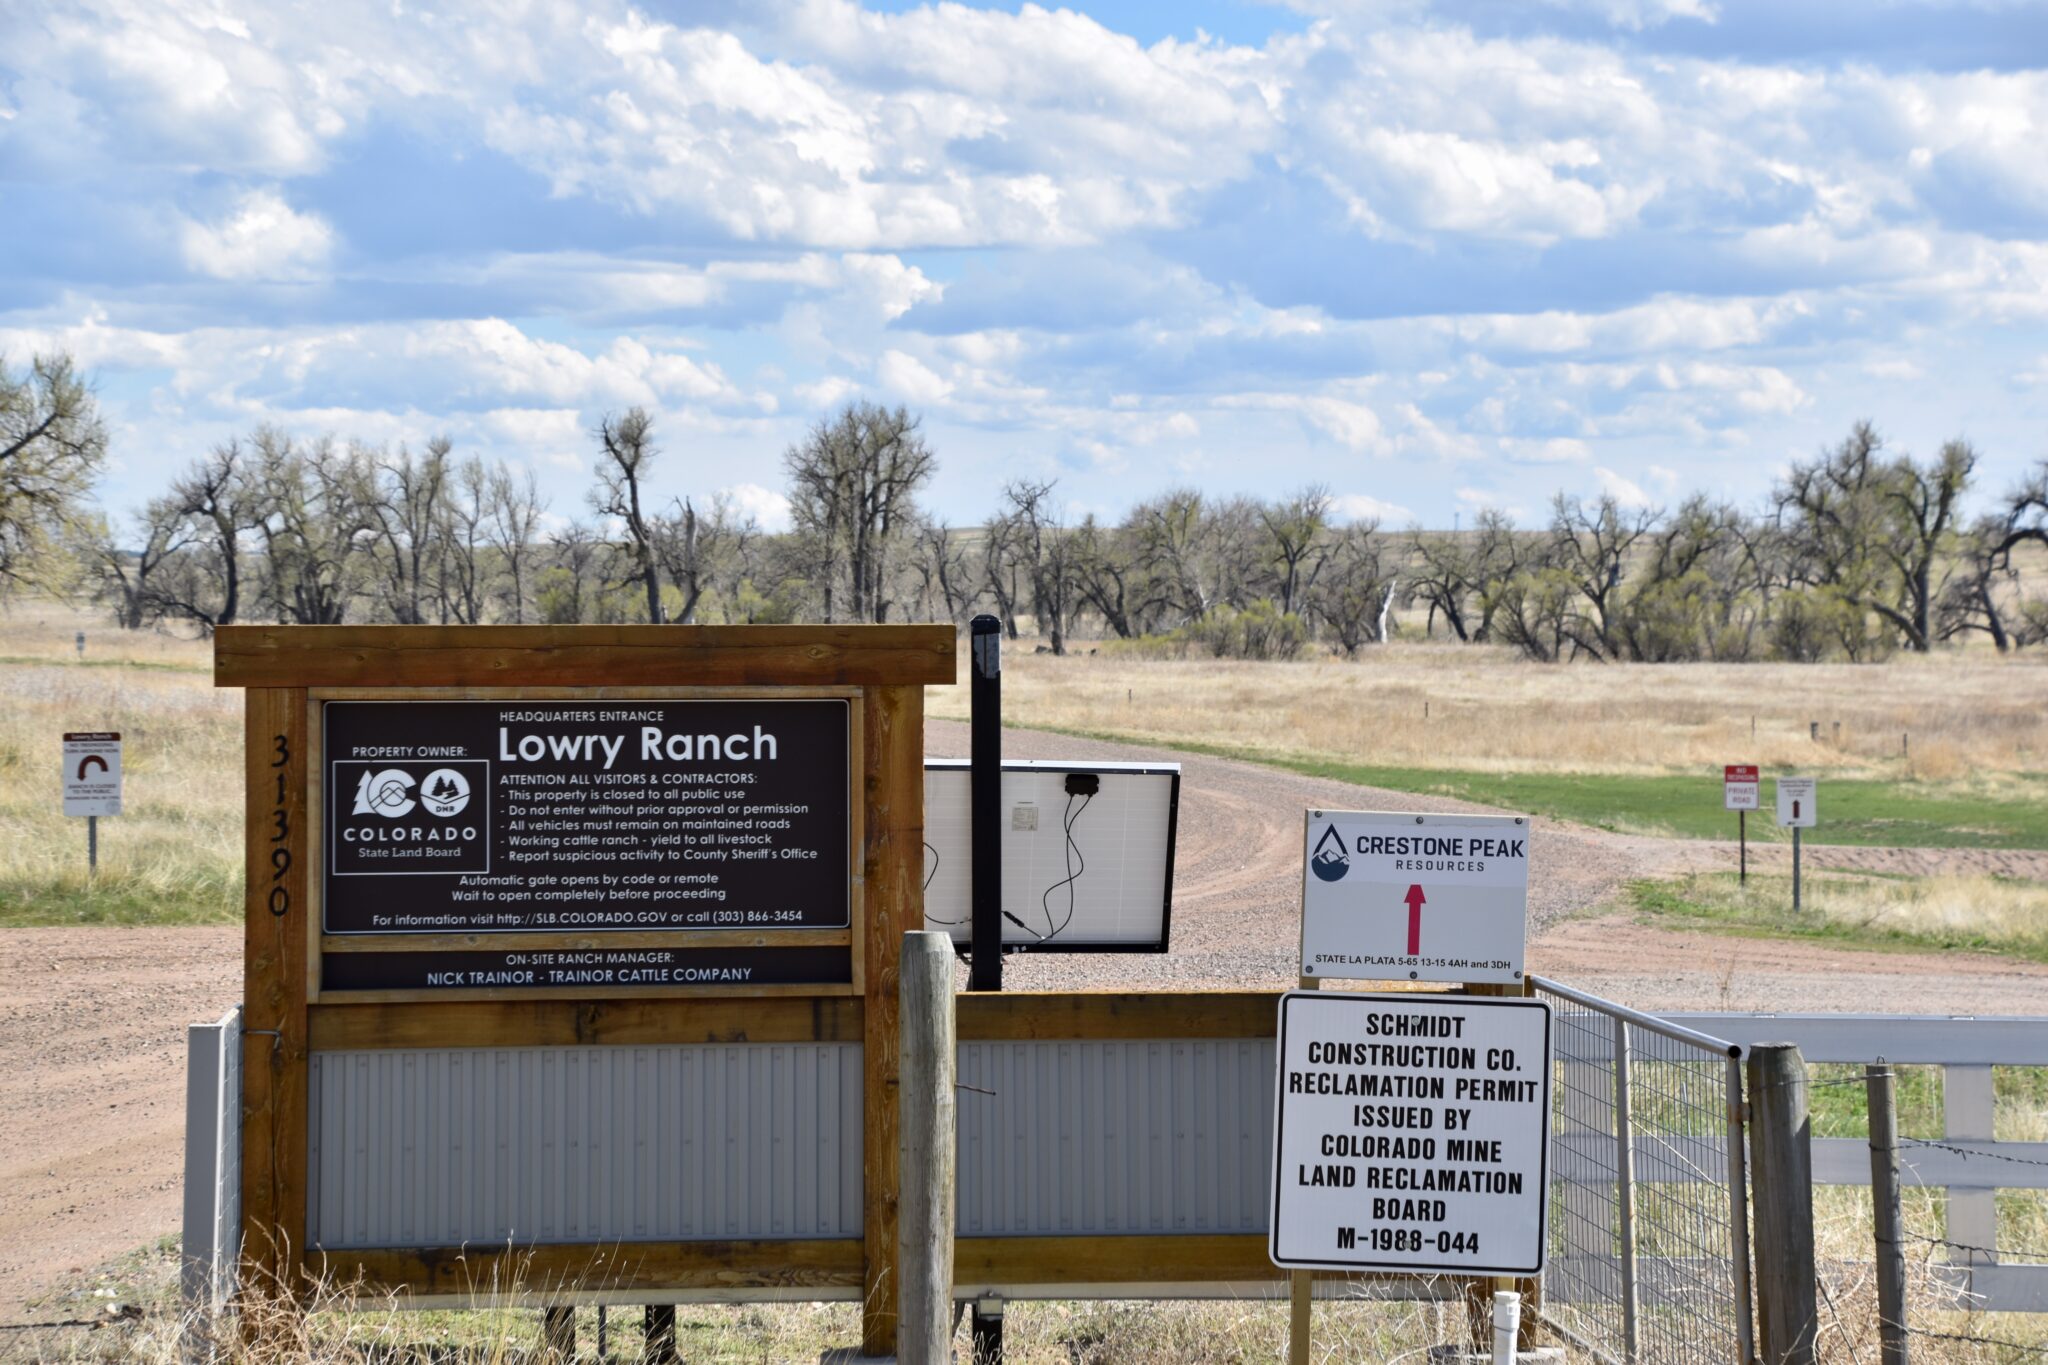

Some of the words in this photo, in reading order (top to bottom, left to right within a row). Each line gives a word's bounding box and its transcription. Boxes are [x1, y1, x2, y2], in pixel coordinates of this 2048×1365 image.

[500, 711, 596, 722] HEADQUARTERS
[599, 710, 664, 721] ENTRANCE
[352, 746, 413, 757] PROPERTY
[417, 746, 467, 757] OWNER:
[500, 727, 625, 769] Lowry
[641, 725, 777, 761] Ranch
[500, 774, 565, 785] ATTENTION
[569, 774, 590, 784] ALL
[593, 773, 646, 784] VISITORS
[650, 774, 658, 784] &
[662, 773, 757, 784] CONTRACTORS:
[508, 789, 531, 800] This
[534, 789, 587, 802] property
[590, 789, 600, 800] is
[602, 789, 644, 800] closed
[648, 789, 660, 800] to
[663, 788, 678, 799] all
[682, 788, 720, 801] public
[724, 790, 745, 799] use
[436, 805, 456, 813] DNR
[509, 805, 526, 815] Do
[530, 805, 550, 815] not
[552, 805, 585, 815] enter
[588, 804, 634, 814] without
[636, 804, 664, 816] prior
[668, 803, 724, 816] approval
[727, 805, 740, 814] or
[743, 803, 808, 816] permission
[268, 734, 292, 917] 31390
[509, 820, 524, 830] All
[528, 820, 580, 830] vehicles
[583, 819, 613, 830] must
[615, 819, 659, 830] remain
[662, 821, 678, 830] on
[682, 818, 752, 829] maintained
[755, 818, 790, 829] roads
[343, 826, 476, 841] COLORADO
[508, 835, 559, 848] Working
[563, 834, 599, 846] cattle
[602, 834, 638, 845] ranch
[650, 834, 681, 847] yield
[684, 834, 696, 844] to
[700, 834, 714, 844] all
[718, 833, 772, 844] livestock
[358, 847, 389, 858] State
[392, 847, 422, 857] Land
[425, 846, 461, 857] Board
[1356, 836, 1463, 856] CRESTONE
[1469, 838, 1524, 858] PEAK
[509, 850, 550, 863] Report
[552, 850, 616, 863] suspicious
[619, 849, 664, 862] activity
[668, 849, 680, 860] to
[683, 849, 728, 862] County
[731, 848, 777, 859] Sheriff's
[780, 848, 818, 859] Office
[1396, 859, 1484, 872] RESOURCES
[459, 874, 524, 885] Automatic
[528, 874, 558, 888] gate
[560, 876, 599, 887] opens
[602, 874, 618, 886] by
[622, 873, 655, 884] code
[658, 875, 671, 884] or
[674, 873, 719, 884] remote
[452, 890, 480, 901] Wait
[482, 890, 495, 901] to
[498, 892, 531, 902] open
[534, 889, 606, 902] completely
[609, 888, 650, 899] before
[653, 888, 726, 901] proceeding
[373, 914, 392, 925] For
[395, 914, 466, 925] information
[470, 913, 494, 924] visit
[497, 911, 667, 926] http://SLB.COLORADO.GOV
[670, 913, 683, 922] or
[686, 911, 709, 922] call
[712, 910, 744, 924] (303)
[747, 910, 802, 922] 866-3454
[506, 953, 554, 965] ON-SITE
[558, 953, 602, 964] RANCH
[606, 952, 674, 963] MANAGER:
[1315, 954, 1346, 964] STATE
[1348, 955, 1362, 964] LA
[1364, 956, 1396, 965] PLATA
[1398, 957, 1418, 966] 5-65
[1420, 958, 1446, 967] 13-15
[1448, 959, 1468, 968] 4AH
[1470, 960, 1488, 968] and
[1491, 960, 1510, 969] 3DH
[427, 972, 464, 985] NICK
[468, 970, 534, 984] TRAINOR
[548, 969, 613, 982] TRAINOR
[618, 968, 668, 982] CATTLE
[673, 968, 751, 981] COMPANY
[1366, 1013, 1466, 1038] SCHMIDT
[1308, 1041, 1476, 1070] CONSTRUCTION
[1486, 1048, 1521, 1071] CO.
[1289, 1071, 1444, 1099] RECLAMATION
[1455, 1078, 1538, 1103] PERMIT
[1354, 1104, 1433, 1129] ISSUED
[1444, 1108, 1471, 1131] BY
[1321, 1134, 1436, 1160] COLORADO
[1446, 1139, 1502, 1163] MINE
[1299, 1164, 1356, 1187] LAND
[1367, 1166, 1522, 1195] RECLAMATION
[1372, 1197, 1446, 1222] BOARD
[1337, 1227, 1479, 1254] M-1988-044
